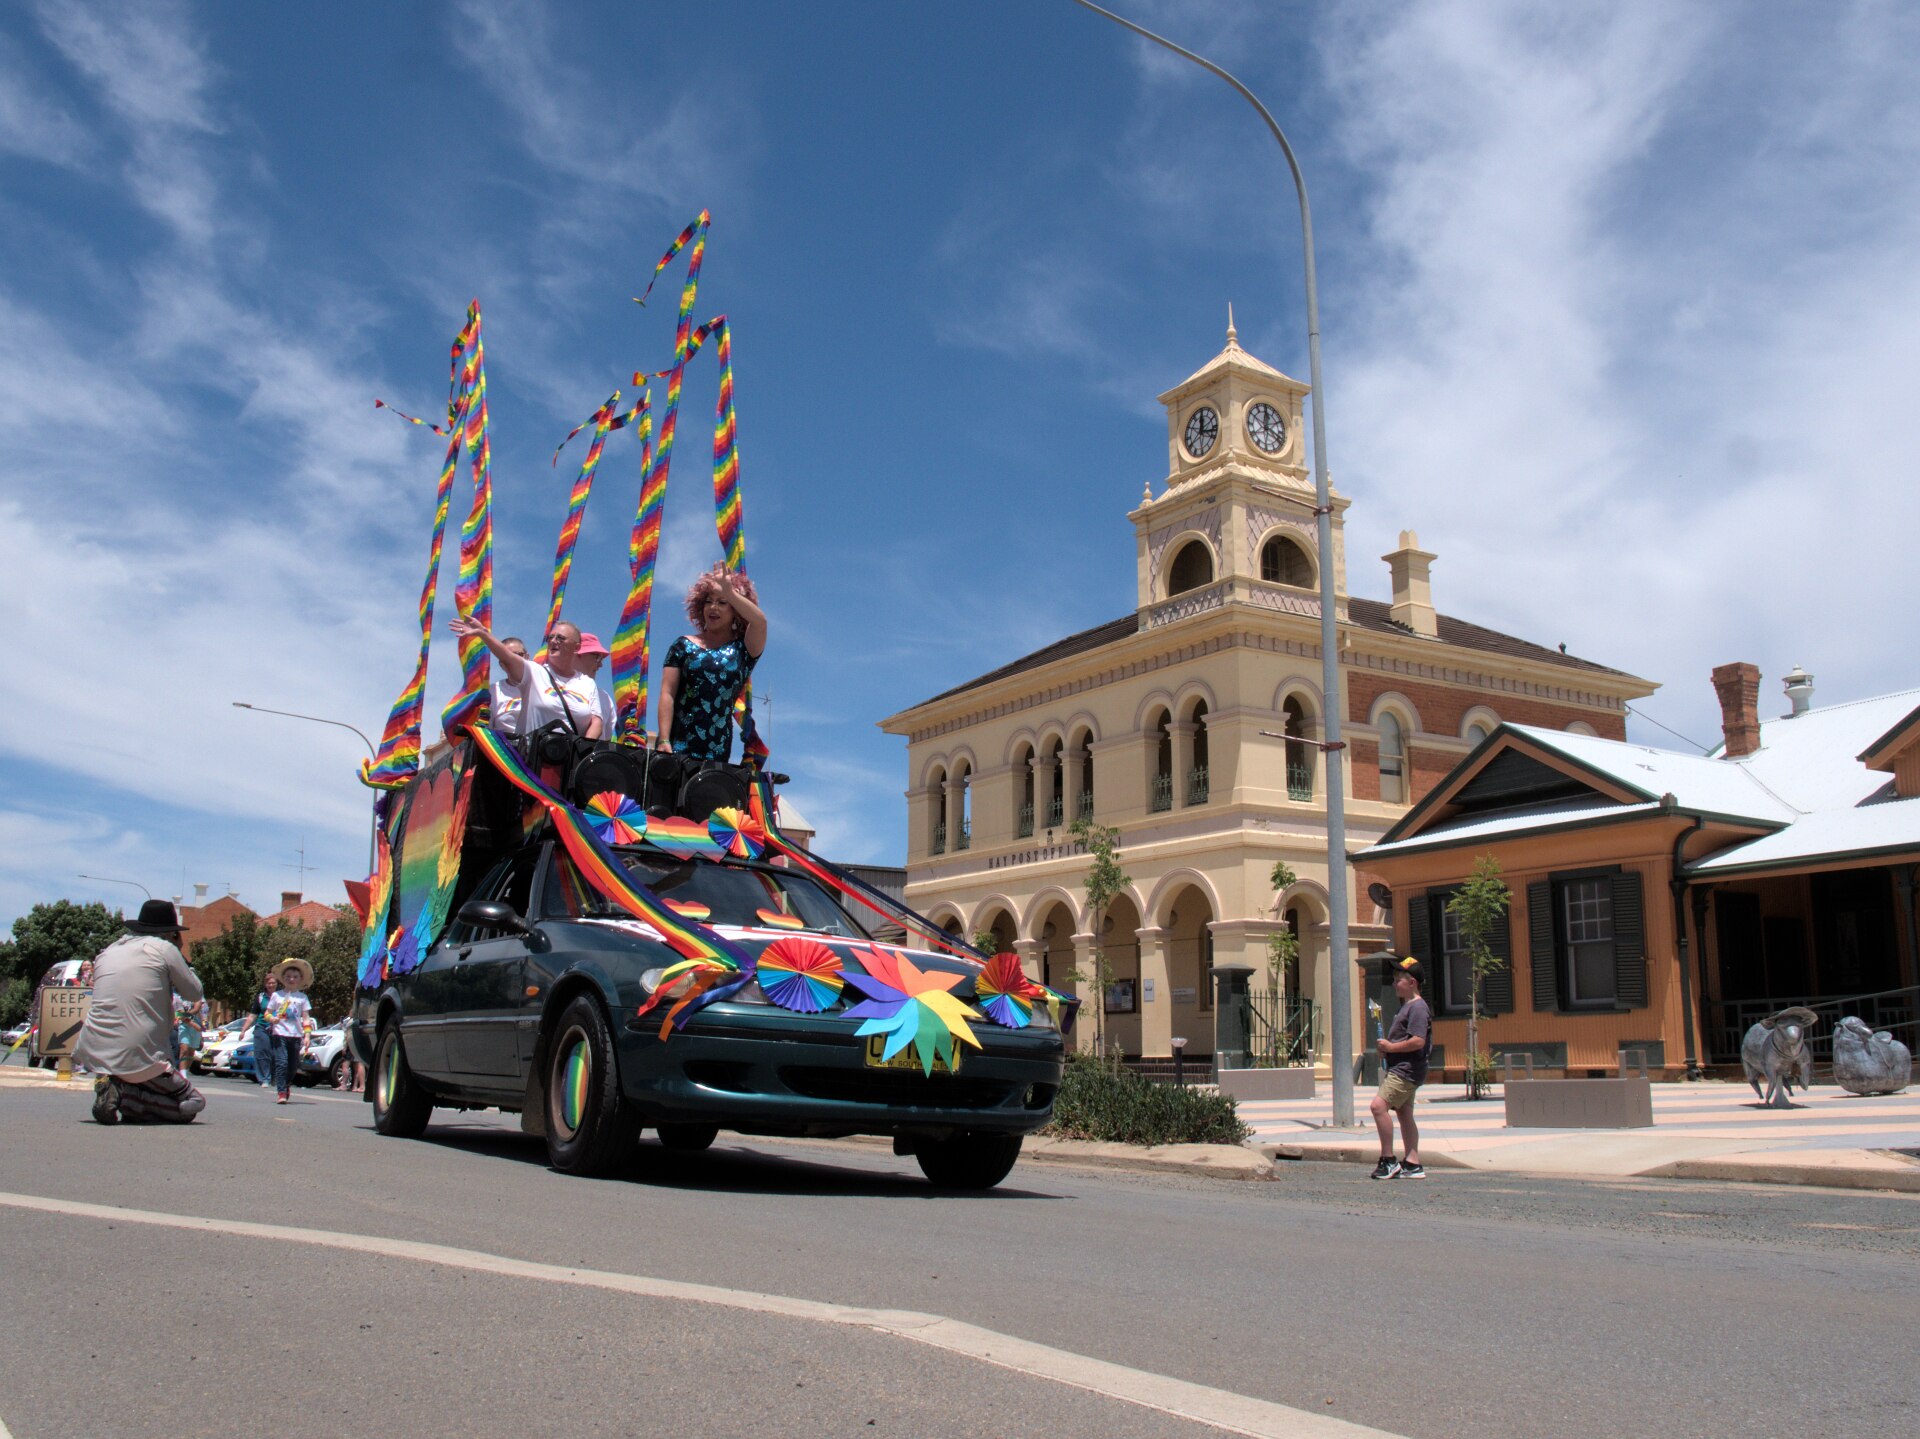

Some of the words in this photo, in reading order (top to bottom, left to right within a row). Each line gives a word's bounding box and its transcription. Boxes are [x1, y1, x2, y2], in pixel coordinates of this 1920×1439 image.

[988, 856, 1007, 869] HAY
[1012, 850, 1039, 865] POST
[50, 993, 86, 1004] KEEP
[51, 1008, 83, 1018] LEFT
[898, 1060, 922, 1068] SOUTH
